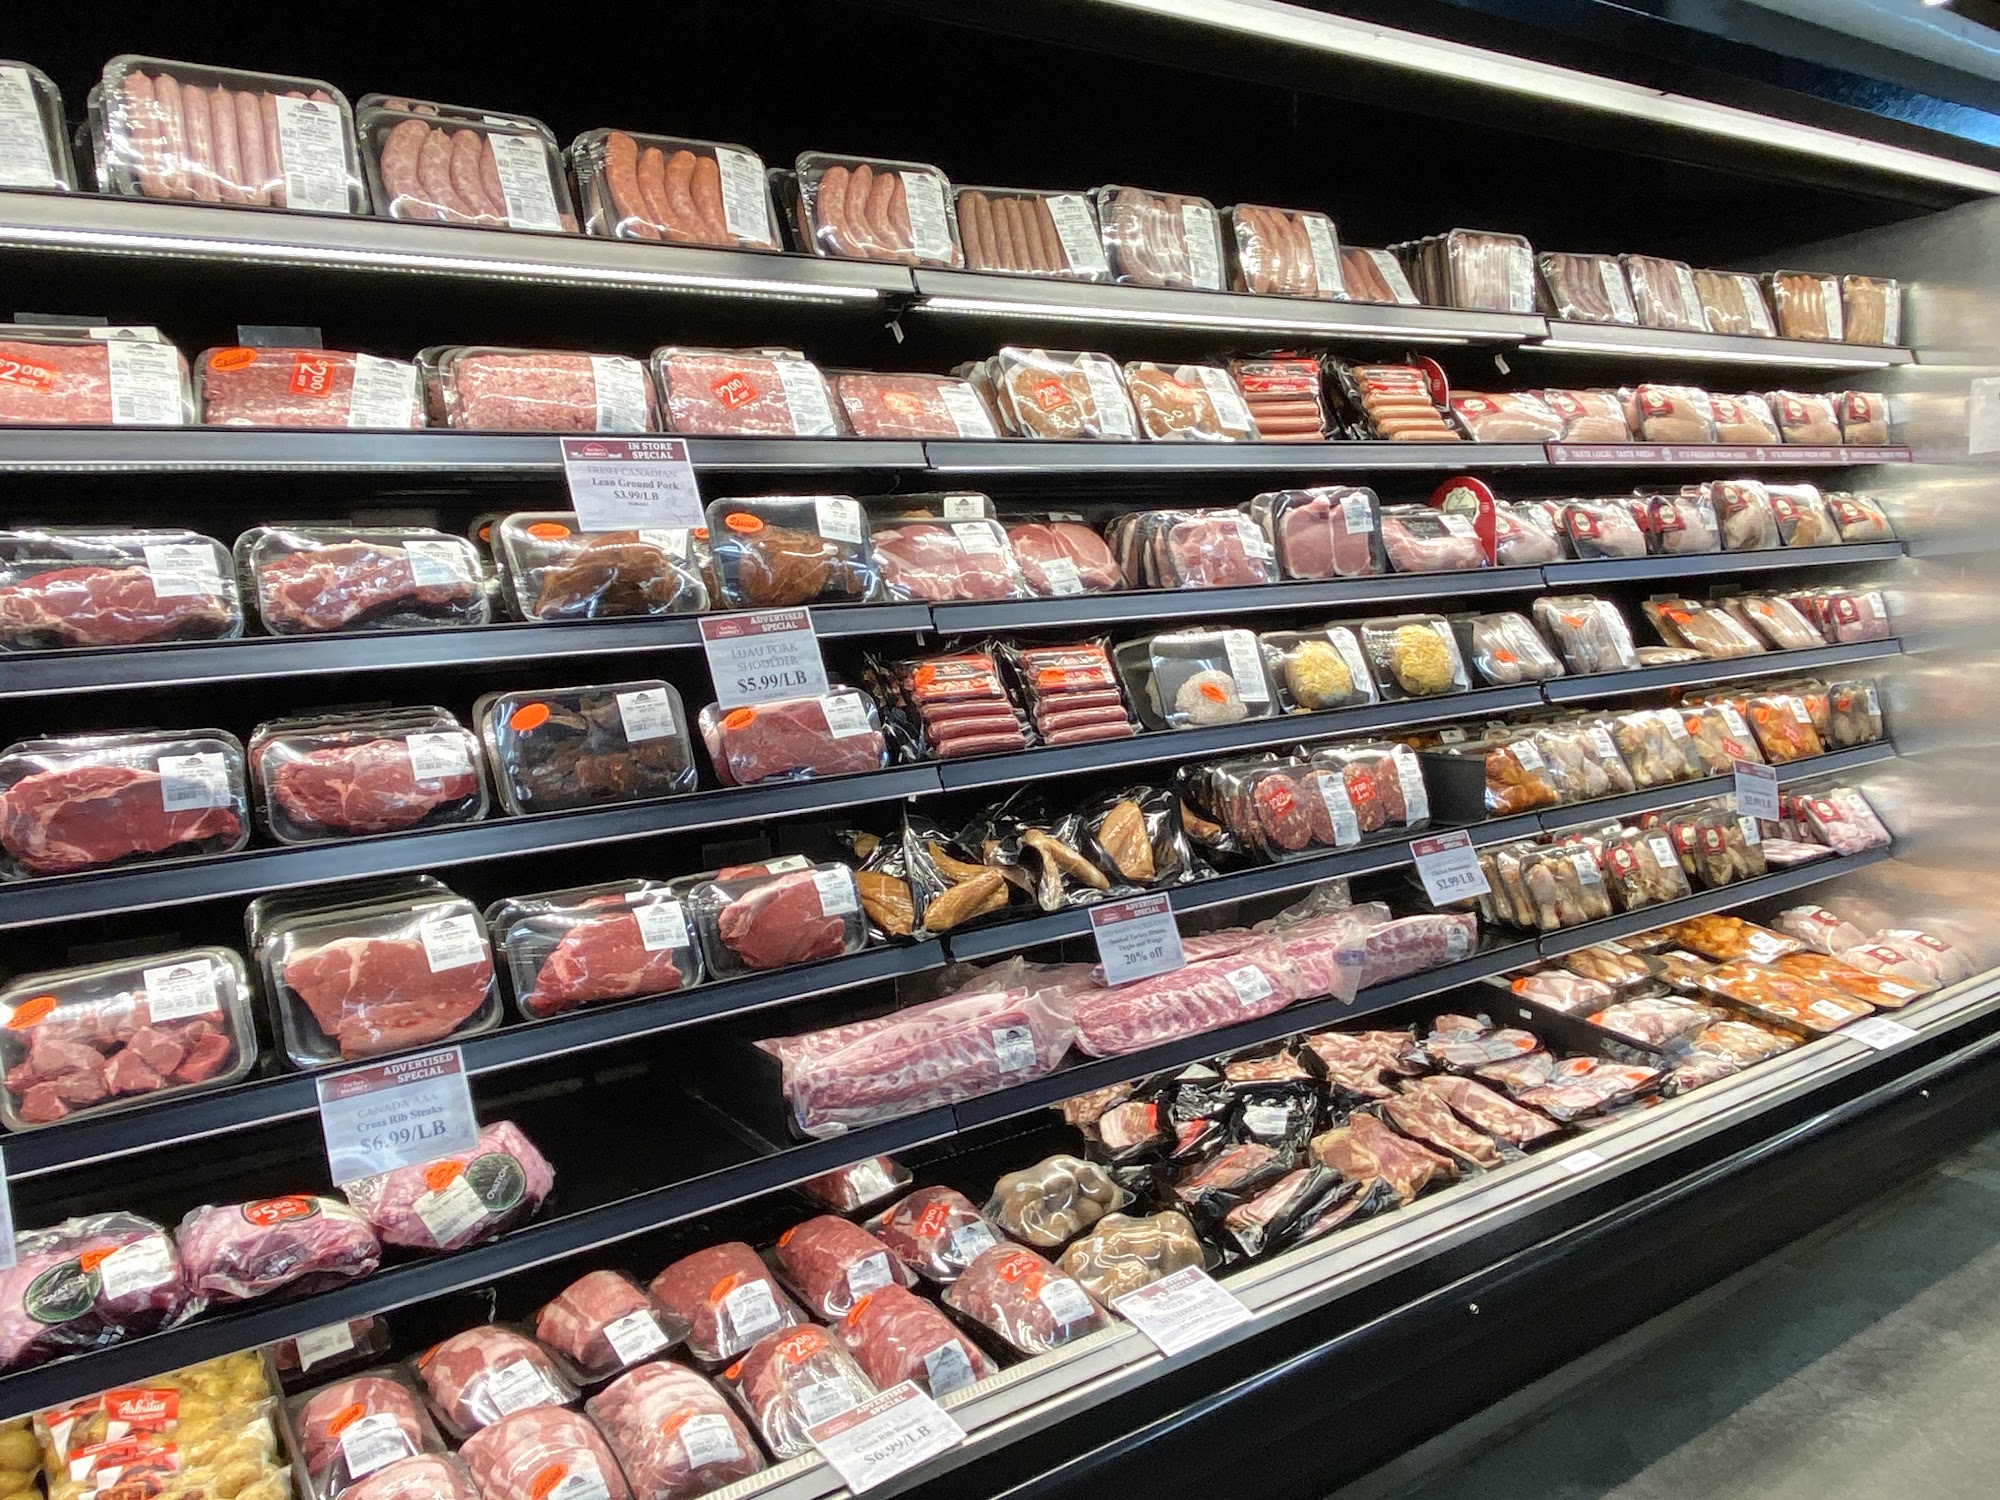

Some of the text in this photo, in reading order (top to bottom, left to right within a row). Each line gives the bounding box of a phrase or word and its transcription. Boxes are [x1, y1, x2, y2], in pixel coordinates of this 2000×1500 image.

[628, 442, 673, 451] IN STORE
[632, 450, 674, 460] SPECIAL
[586, 465, 678, 479] FRESH CANADIAN
[592, 477, 680, 491] Lean Ground Pork
[613, 490, 660, 501] $3.99/LB
[750, 611, 804, 625] ADVERTISED
[761, 620, 799, 633] SPECIAL
[731, 642, 799, 660] LUAU PORK
[737, 655, 799, 673] SHOULDER
[737, 670, 808, 694] $5.99/LB
[1123, 946, 1164, 965] 20% off
[382, 1052, 455, 1077] ADVERTISED
[397, 1065, 445, 1084] SPECIAL
[357, 1117, 388, 1134] Cross
[389, 1111, 408, 1126] Rib
[360, 1118, 447, 1155] $6.99/LB
[856, 1385, 910, 1416] ADVERTISED
[869, 1395, 907, 1417] SPECIAL
[863, 1425, 932, 1466] $6.99/LB
